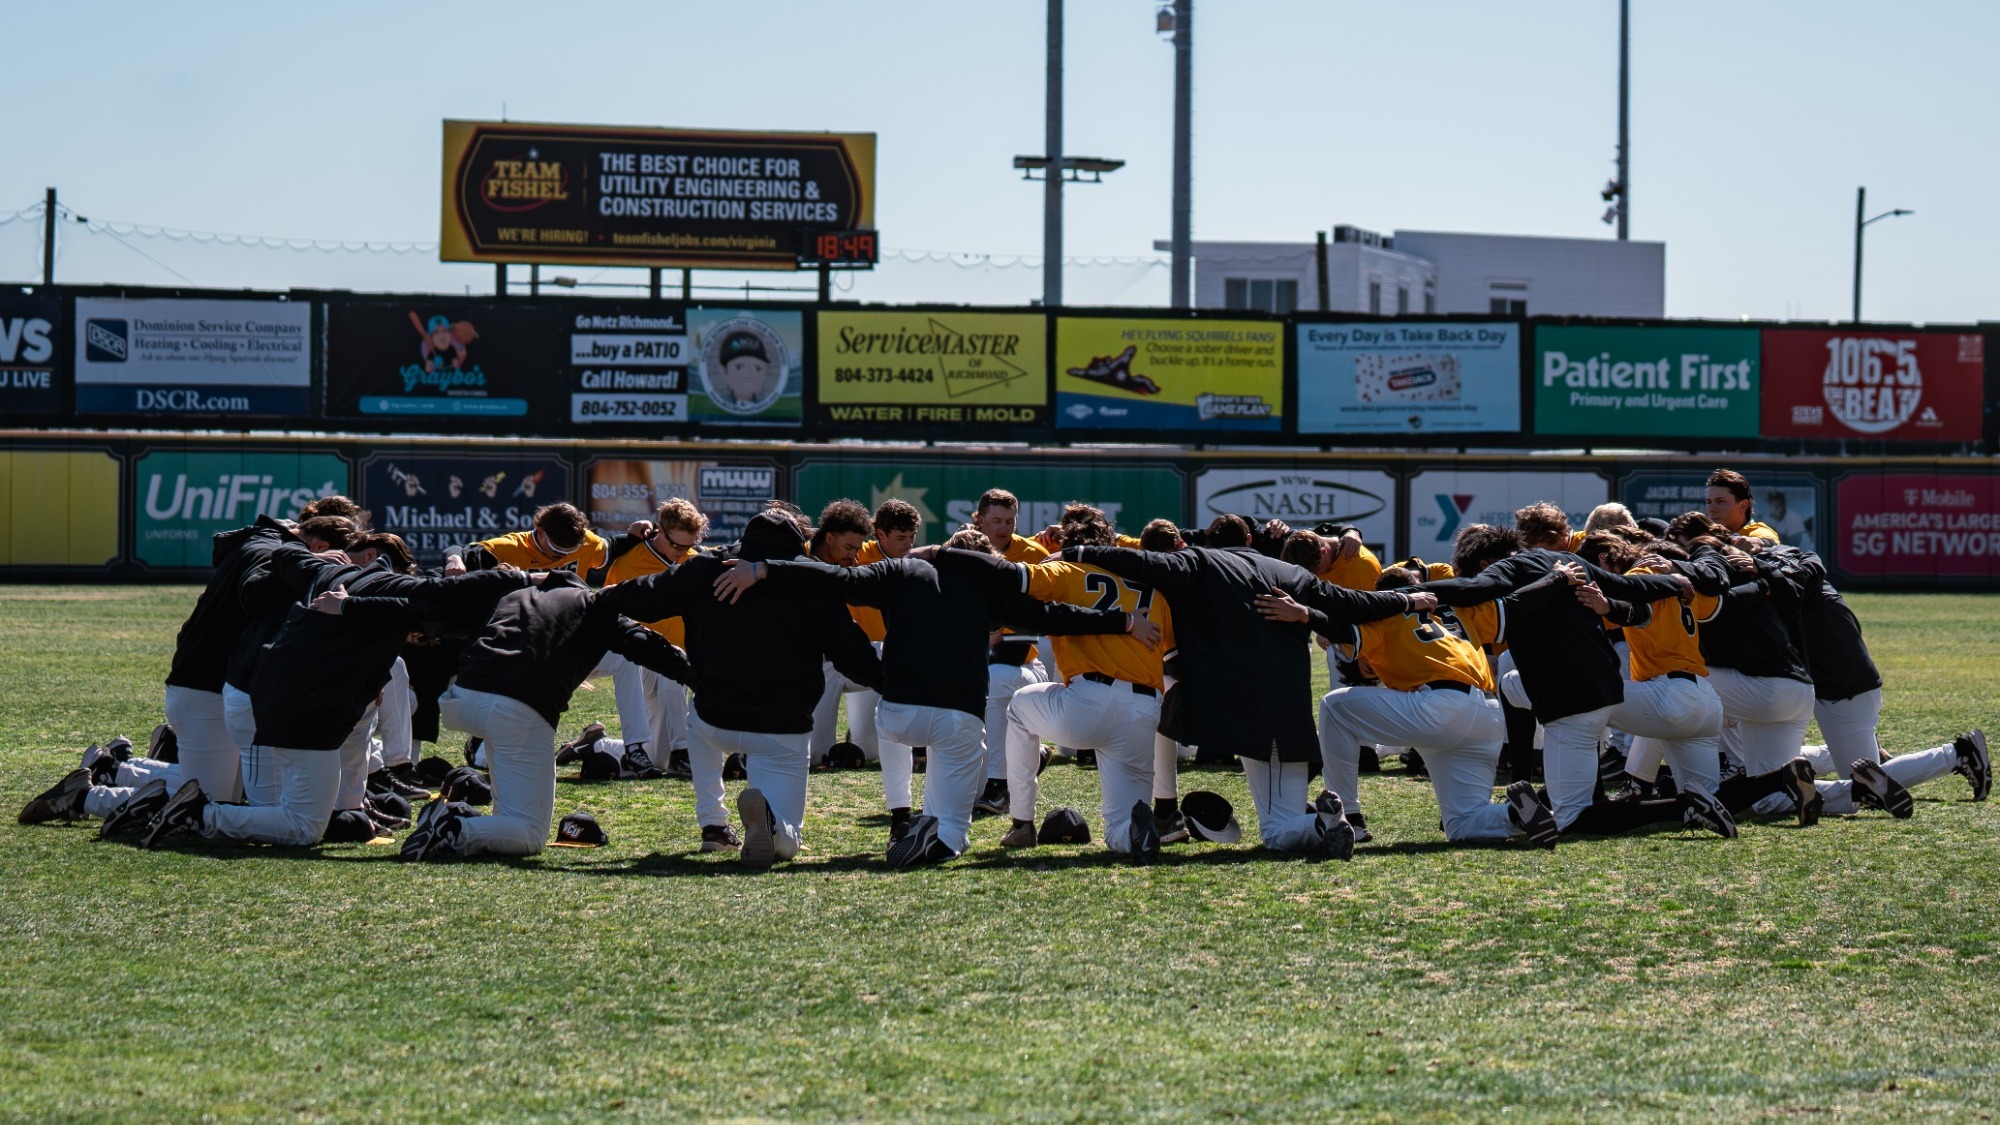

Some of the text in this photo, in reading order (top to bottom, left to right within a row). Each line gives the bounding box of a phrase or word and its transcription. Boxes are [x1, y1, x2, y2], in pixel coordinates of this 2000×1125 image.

[494, 160, 561, 181] TEAM
[600, 152, 801, 178] THE BEST CHOICE FOR
[488, 179, 568, 199] FISHEL
[600, 175, 821, 200] UTILITY ENGINEERING &
[600, 197, 838, 222] CONSTRUCTION SERVICES
[497, 228, 589, 244] WE'RE HIRING!
[613, 232, 776, 249] teamfisheljobs.com/virginia
[816, 234, 874, 259] 18:49
[134, 319, 303, 337] Dominion Service Company
[575, 315, 683, 330] Go Nutz Richmond...
[134, 337, 303, 352] Heating Cooling Electrical
[836, 325, 1020, 356] ServiceMASTER
[1146, 330, 1184, 341] FLYING
[1185, 330, 1244, 342] SQUIRRELS
[1308, 328, 1508, 345] Every Day is Take Back Day
[575, 341, 680, 360] ...buy a PATIO
[1146, 342, 1275, 356] Choose a sober driver and
[968, 358, 983, 368] OF
[1150, 355, 1184, 366] buckle
[1225, 357, 1256, 367] home
[1826, 337, 1918, 386] 106.5
[13, 371, 51, 389] LIVE
[581, 370, 679, 389] Call Howard!
[834, 368, 934, 383] 804-373-4424
[947, 370, 1008, 379] RICHMOND
[1543, 351, 1751, 391] Patient First
[136, 389, 250, 411] DSCR.com
[581, 401, 677, 416] 804-752-0052
[1570, 392, 1728, 411] Primary and Urgent Care
[1845, 387, 1915, 422] BEAT
[830, 406, 1036, 421] WATER FIRE MOLD
[1254, 493, 1336, 515] NASH
[1921, 489, 1975, 507] Mobile
[385, 505, 534, 529] Michael & So
[1417, 516, 1437, 527] the
[1852, 513, 1944, 529] AMERICA'S
[146, 529, 199, 540] UNIFORMS
[1852, 532, 1887, 556] 5G
[1085, 572, 1156, 620] 27
[563, 820, 585, 839] VCU
